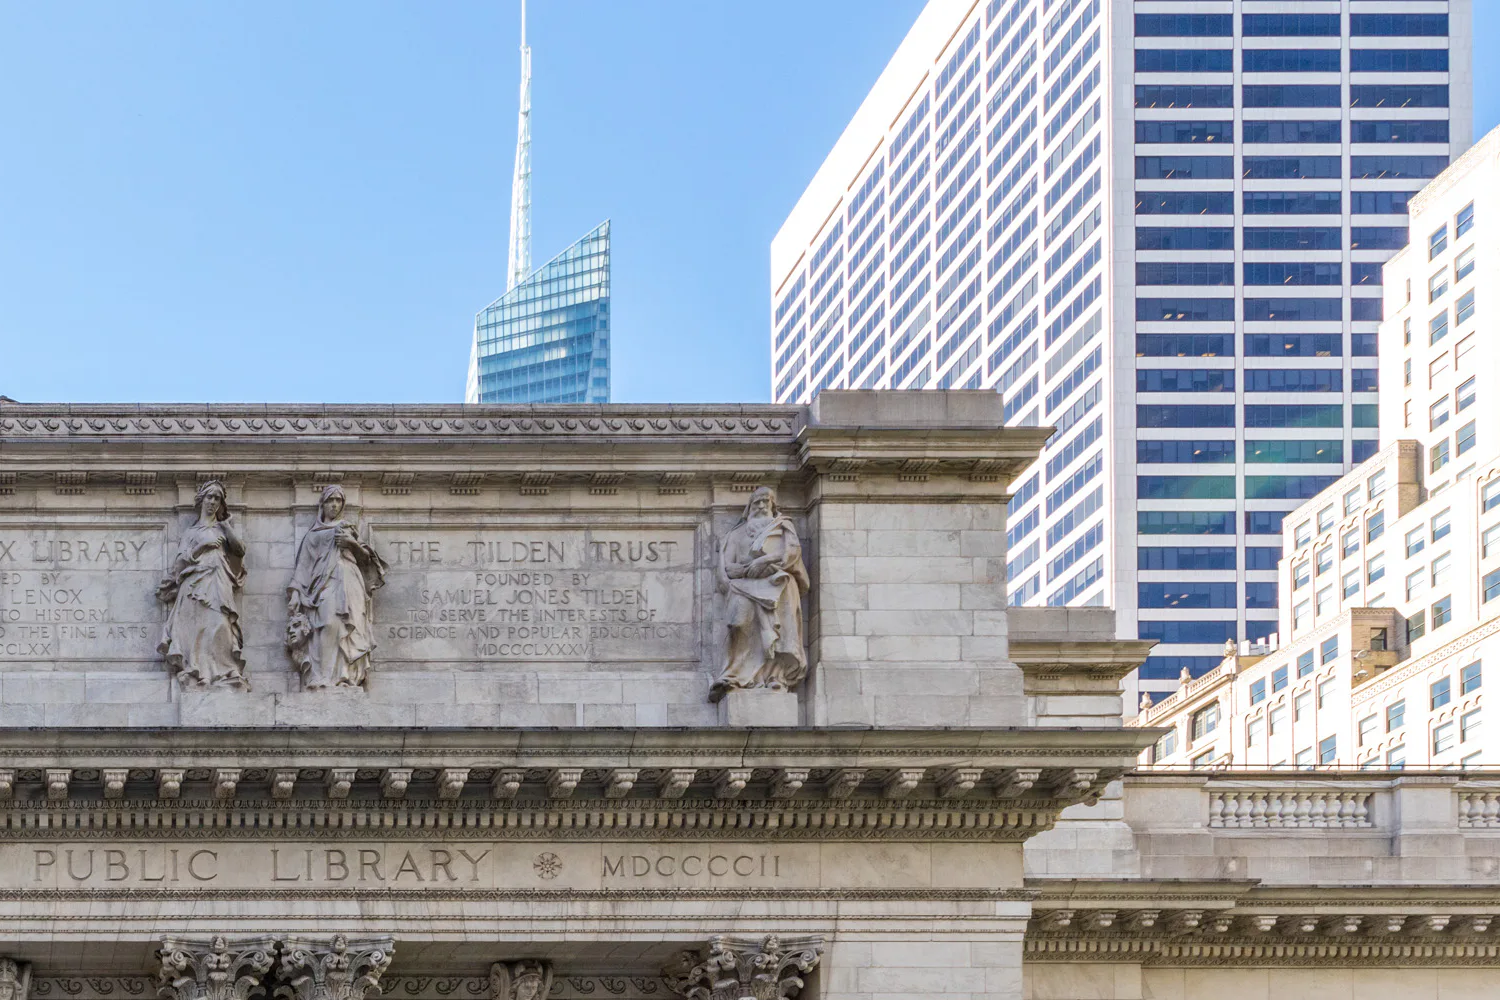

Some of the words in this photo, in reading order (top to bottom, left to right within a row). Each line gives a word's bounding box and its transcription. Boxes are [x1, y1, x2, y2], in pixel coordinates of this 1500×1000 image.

[33, 541, 147, 562] LIBRARY
[389, 541, 442, 563] THE
[467, 541, 564, 563] TILDEN
[589, 541, 678, 562] TRUST
[41, 572, 60, 585] BY
[475, 573, 553, 585] FOUNDED
[572, 573, 590, 585] BY
[11, 589, 83, 605] LENOX
[420, 590, 498, 604] SAMUEL
[506, 590, 570, 604] JONES
[581, 590, 648, 604] TILDEN
[0, 608, 20, 621] TO
[407, 609, 430, 621] TO
[439, 609, 487, 621] SERVE
[498, 609, 530, 621] THE
[539, 609, 627, 621] INTERESTS
[637, 609, 656, 621] OF
[16, 626, 50, 639] THE
[60, 626, 97, 639] FINE
[106, 626, 148, 639] ARTS
[388, 627, 457, 639] SCIENCE
[467, 627, 500, 639] AND
[507, 627, 582, 639] POPULAR
[590, 626, 681, 639] EDUCATION
[33, 849, 218, 881] PUBLIC
[270, 849, 492, 881] LIBRARY
[602, 855, 781, 877] MDCCCCII
